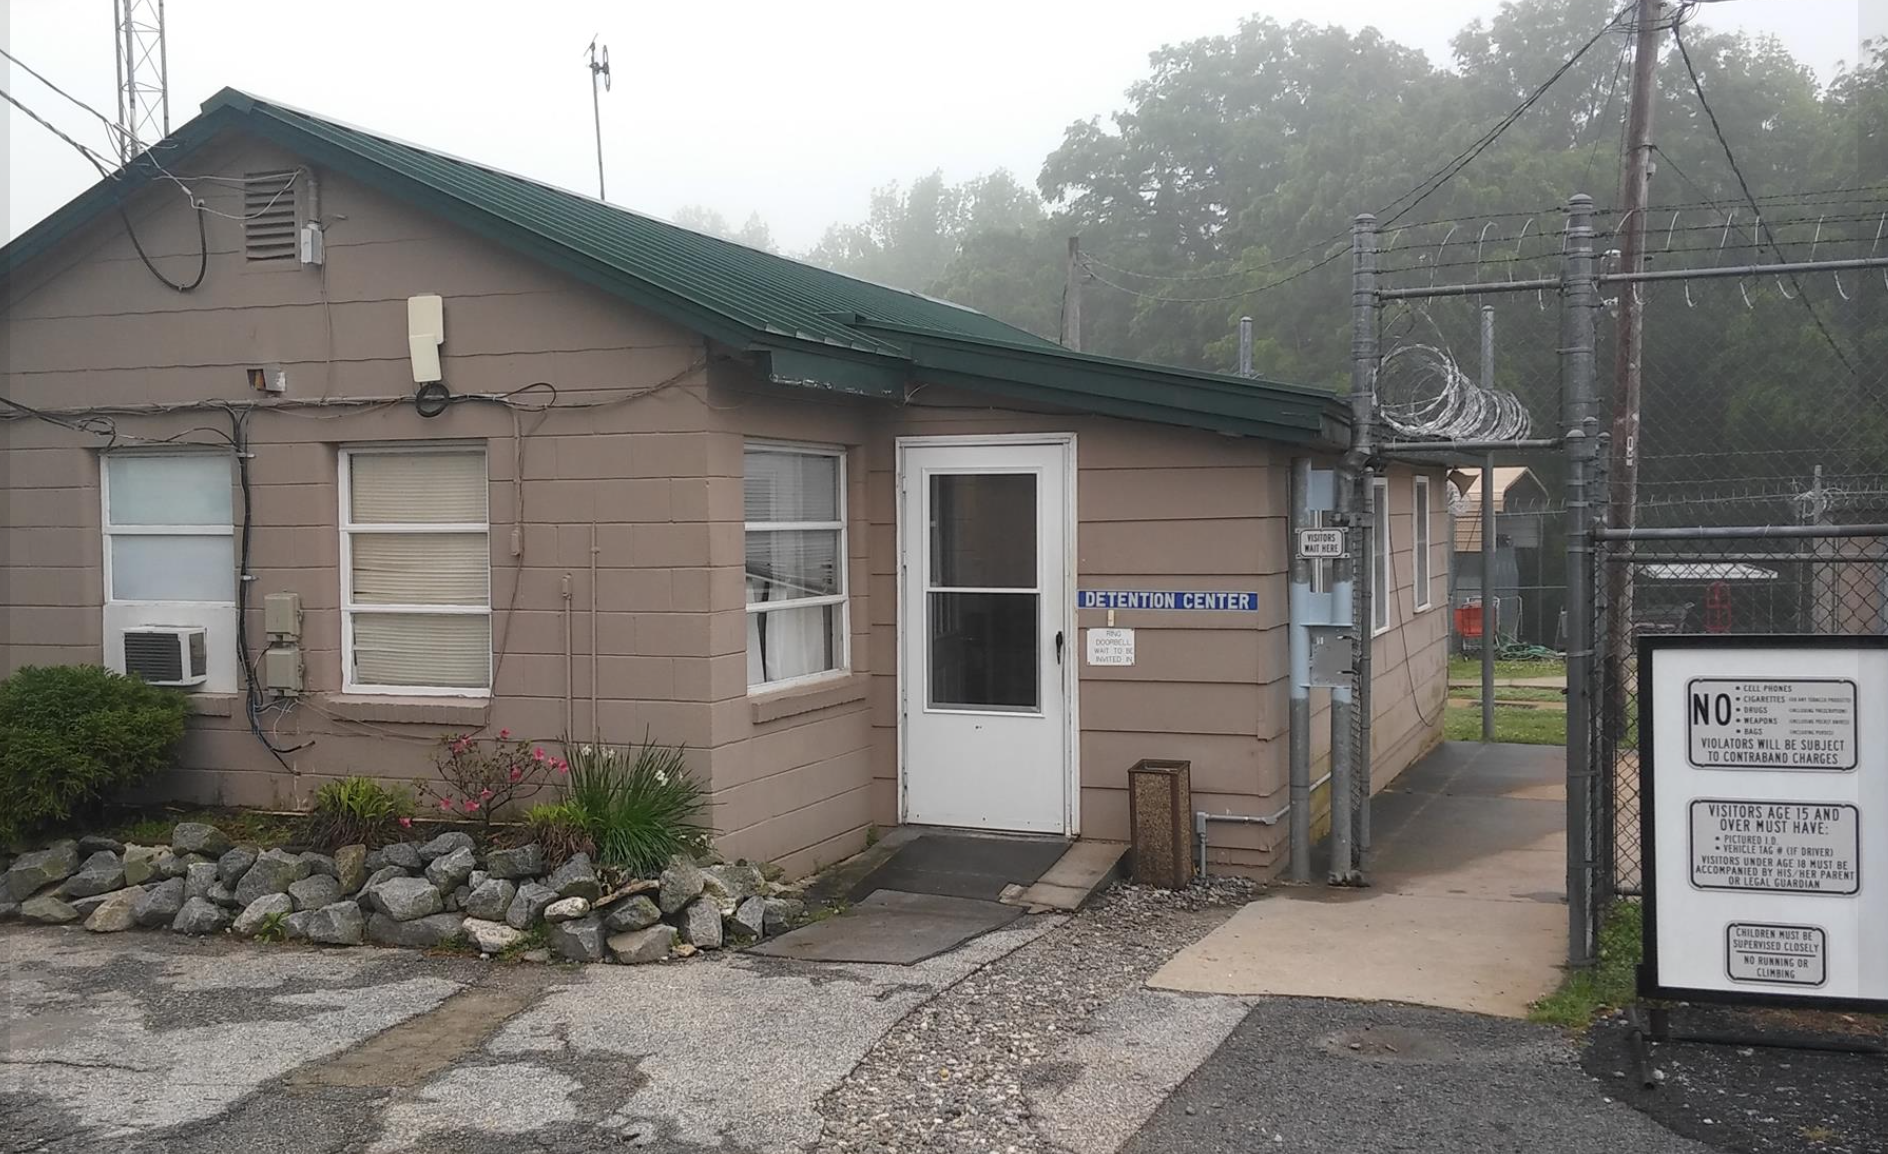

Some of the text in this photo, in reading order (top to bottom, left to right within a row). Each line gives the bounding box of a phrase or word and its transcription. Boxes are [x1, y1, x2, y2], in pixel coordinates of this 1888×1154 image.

[1307, 533, 1336, 542] VISITORS
[1304, 544, 1339, 553] WAIT HERE
[1085, 591, 1249, 609] DETENTION CENTER
[1694, 693, 1732, 726] NO
[1701, 738, 1845, 752] VIOLATORS WILL BE SUBJECT
[1708, 751, 1838, 765] TO CONTRABAND CHARGES
[1708, 804, 1840, 822] VISITORS AGE 15 AND
[1720, 819, 1829, 835] OVER MUST HAVE:
[1724, 834, 1762, 845] PICTURED
[1724, 844, 1756, 854] VEHICLE
[1758, 846, 1773, 854] TAG
[1786, 846, 1799, 856] (IF
[1802, 847, 1834, 858] DRIVER)
[1702, 855, 1848, 870] VISITORS UNDER AGE 18 MUST BE
[1696, 865, 1854, 881] ACCOMPANIED BY HIS/HER PARENT
[1728, 876, 1820, 889] OR LEGAL GUARDIAN
[1736, 928, 1812, 940] CHILDREN MUST BE
[1733, 939, 1820, 953] SUPERVISED CLOSELY
[1744, 956, 1808, 968] NO RUNNING OR
[1756, 968, 1796, 978] CLIMBING
